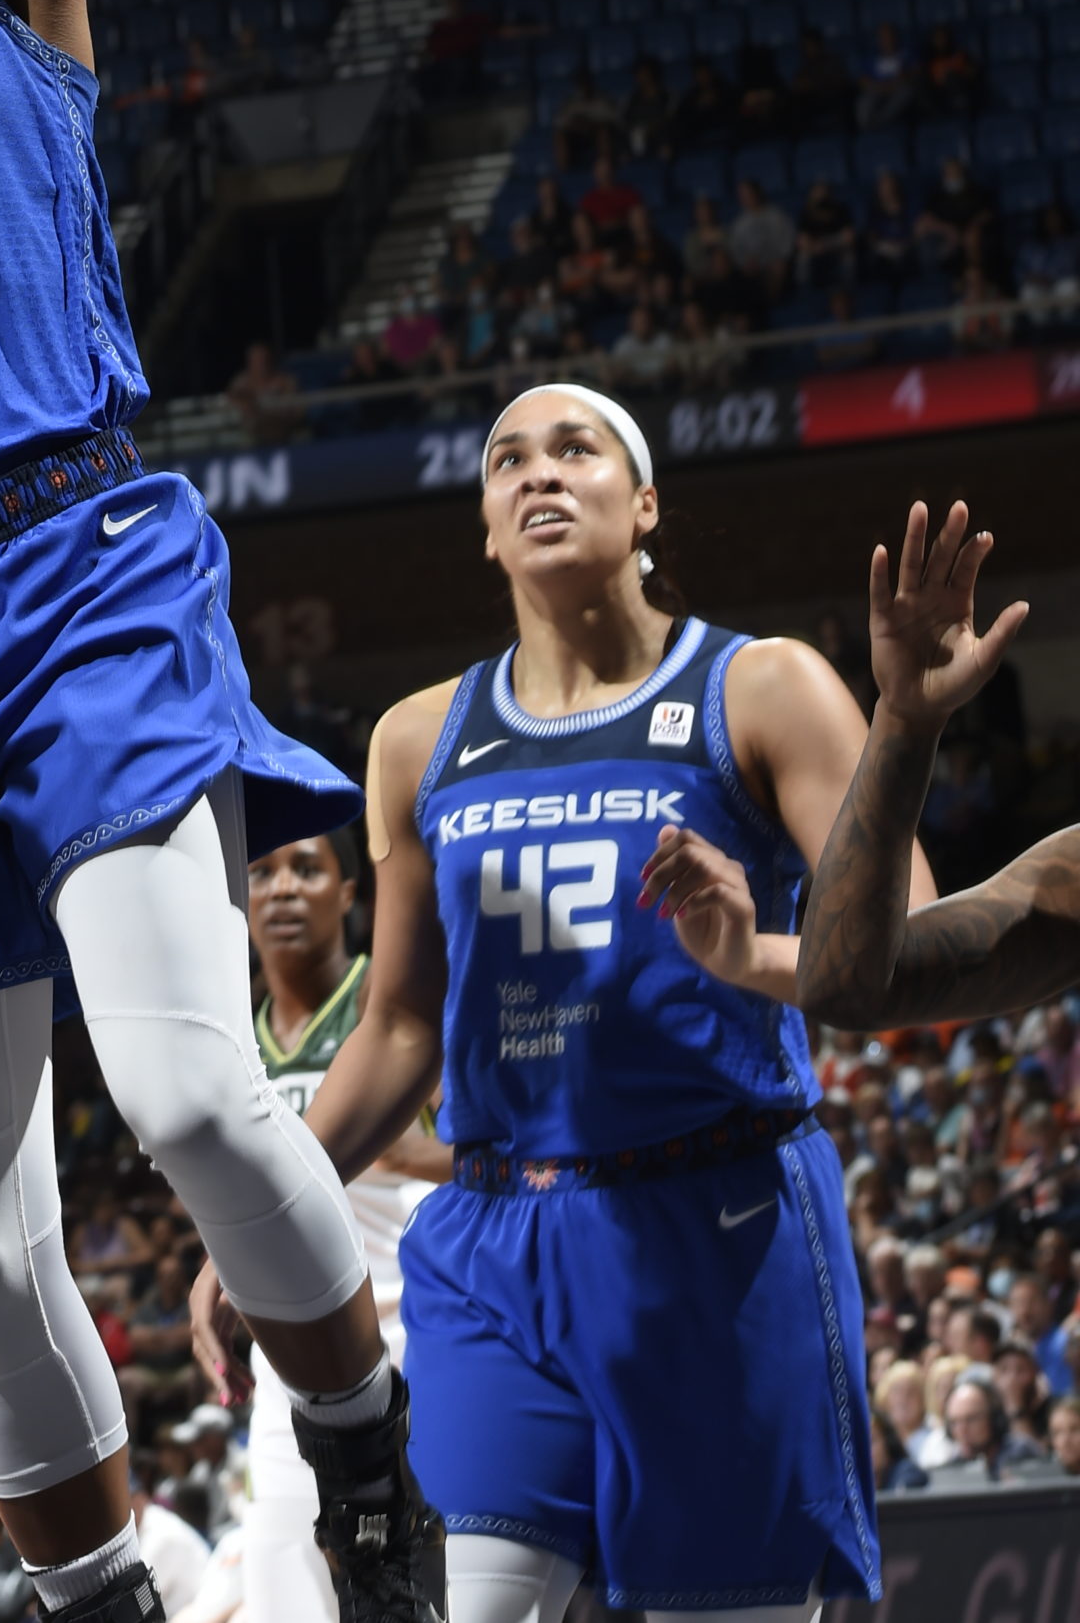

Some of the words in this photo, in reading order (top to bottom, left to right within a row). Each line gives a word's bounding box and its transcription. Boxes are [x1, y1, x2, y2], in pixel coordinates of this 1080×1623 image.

[438, 789, 684, 846] KEESUSK
[480, 839, 618, 954] 42
[497, 981, 537, 1005] Yale
[500, 1003, 599, 1033] NewHaven
[500, 1033, 564, 1061] Health
